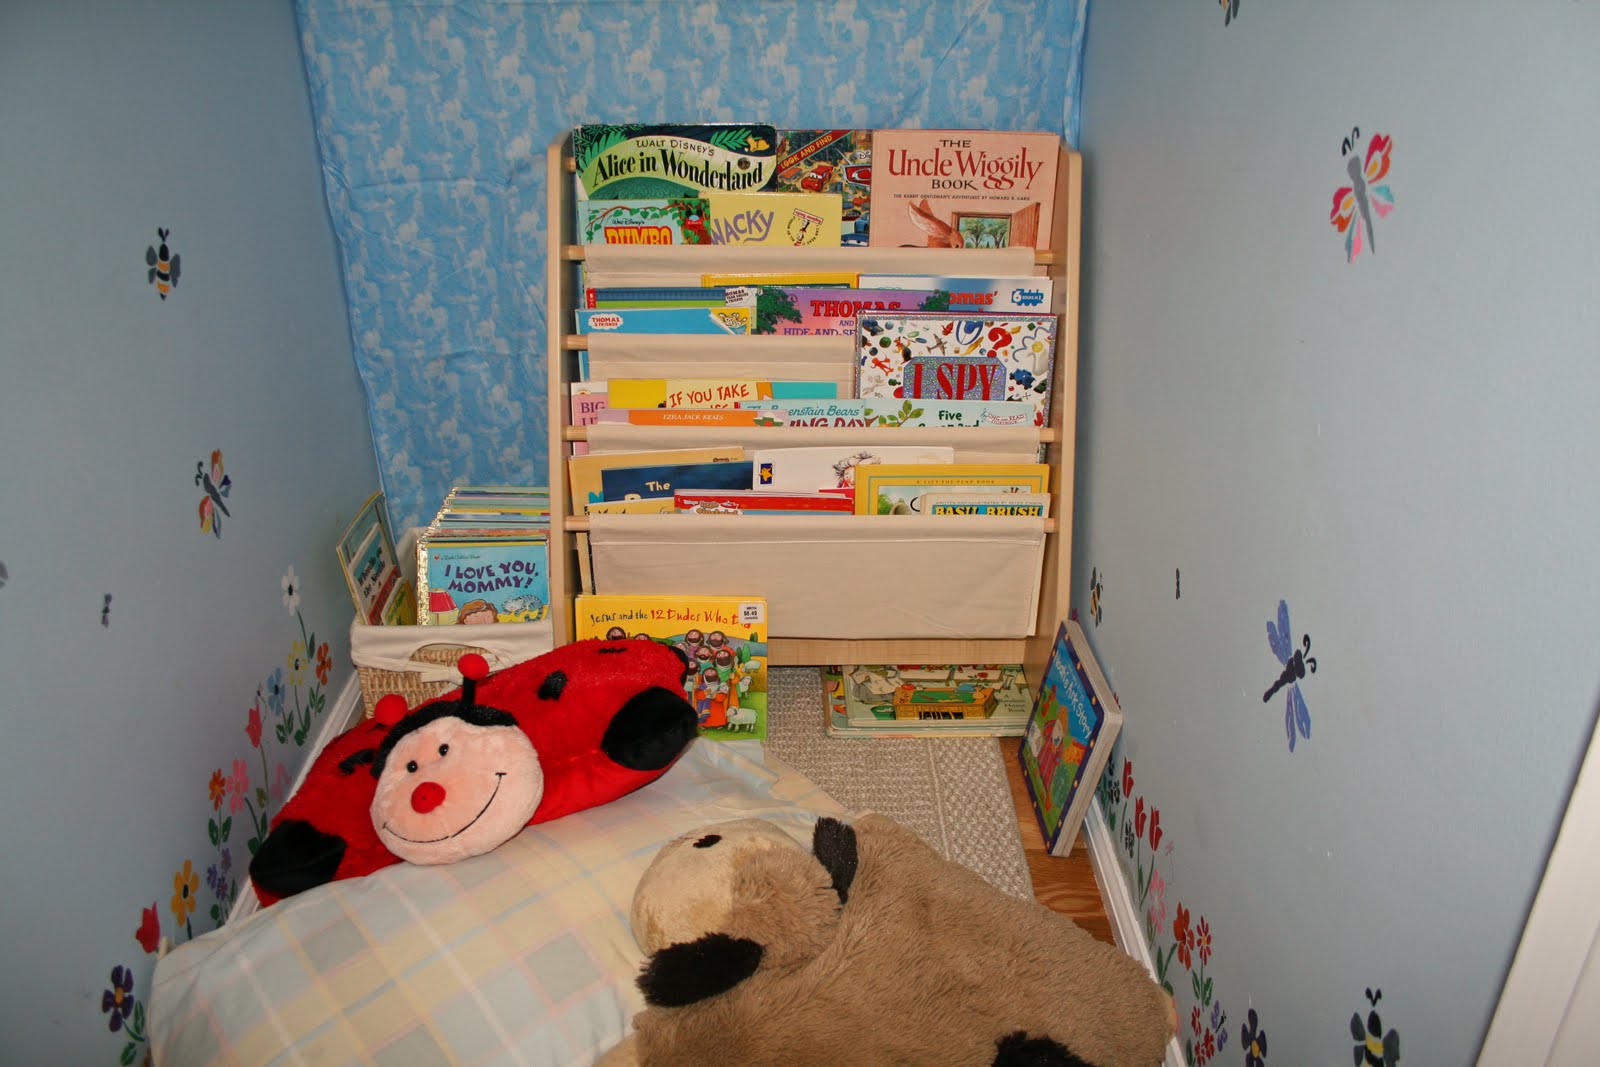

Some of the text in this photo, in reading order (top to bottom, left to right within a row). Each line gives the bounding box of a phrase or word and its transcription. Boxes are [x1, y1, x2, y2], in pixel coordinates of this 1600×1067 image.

[636, 139, 716, 157] WALT DISNEY'S
[780, 135, 832, 169] LOOK AND FIND
[939, 139, 972, 148] THE
[592, 149, 763, 192] Alice in Wonderland
[888, 146, 1045, 190] Uncle Wiggily
[931, 178, 978, 190] BOOK
[604, 226, 672, 244] DUMBO
[710, 209, 774, 246] WACKY
[948, 290, 998, 305] omas'
[1013, 290, 1022, 302] 6
[913, 362, 998, 400] I SPY
[669, 384, 750, 408] IF YOU TAKE
[788, 405, 864, 416] enstain Bears'
[938, 410, 962, 420] Five
[645, 481, 671, 492] The
[986, 506, 1040, 516] BRUSH
[445, 560, 539, 579] I LOVE YOU,
[448, 575, 534, 594] MOMMY!
[591, 612, 616, 626] Jesus
[619, 610, 633, 620] and
[636, 609, 649, 620] the
[650, 609, 665, 620] 12
[668, 608, 701, 622] Dudes
[704, 609, 728, 624] Who
[1076, 703, 1093, 739] Story
